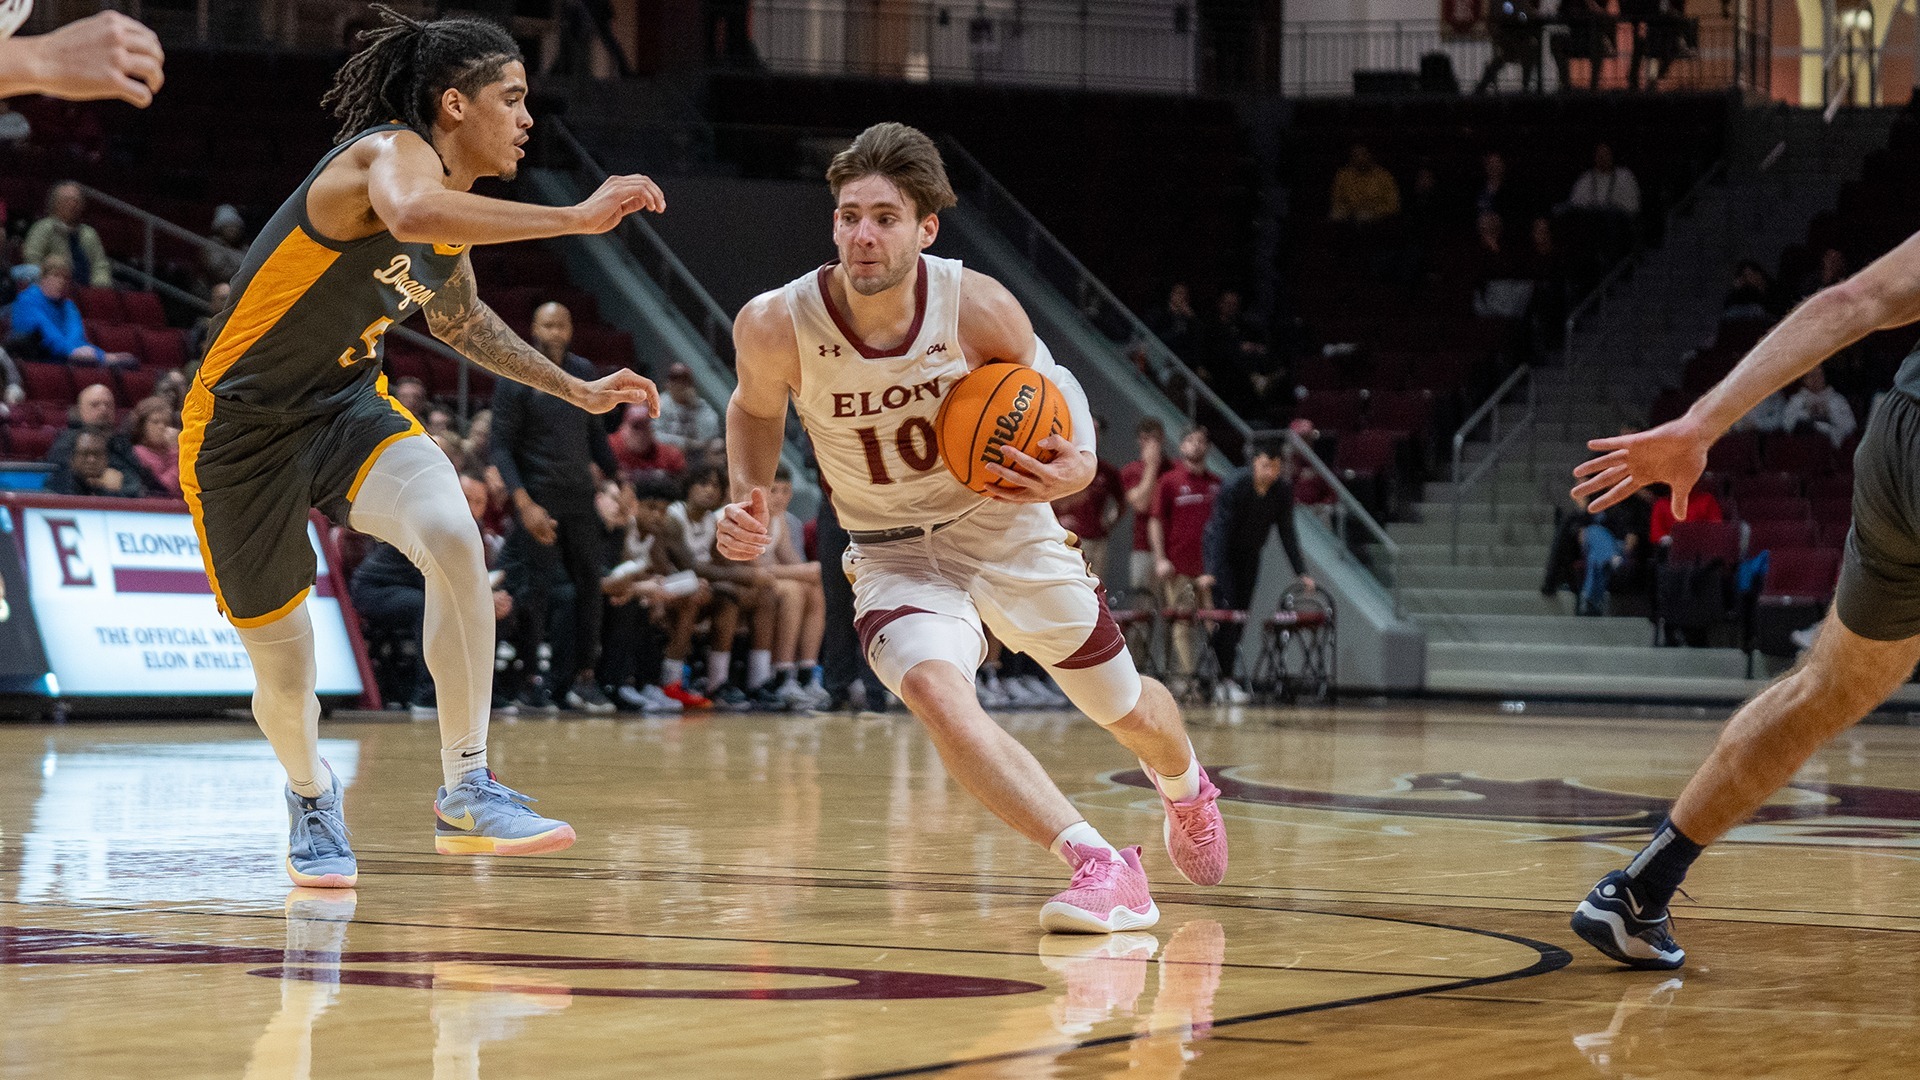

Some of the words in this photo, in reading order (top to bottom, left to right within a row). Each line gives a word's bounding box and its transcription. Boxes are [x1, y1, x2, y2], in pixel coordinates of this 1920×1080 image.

[338, 315, 394, 368] 5
[926, 342, 948, 356] CAA
[831, 376, 941, 418] ELON
[981, 384, 1038, 465] Wilson
[849, 416, 939, 485] 10
[44, 517, 94, 587] E
[95, 626, 131, 645] THE
[134, 627, 209, 645] OFFICIAL
[143, 650, 189, 669] ELON
